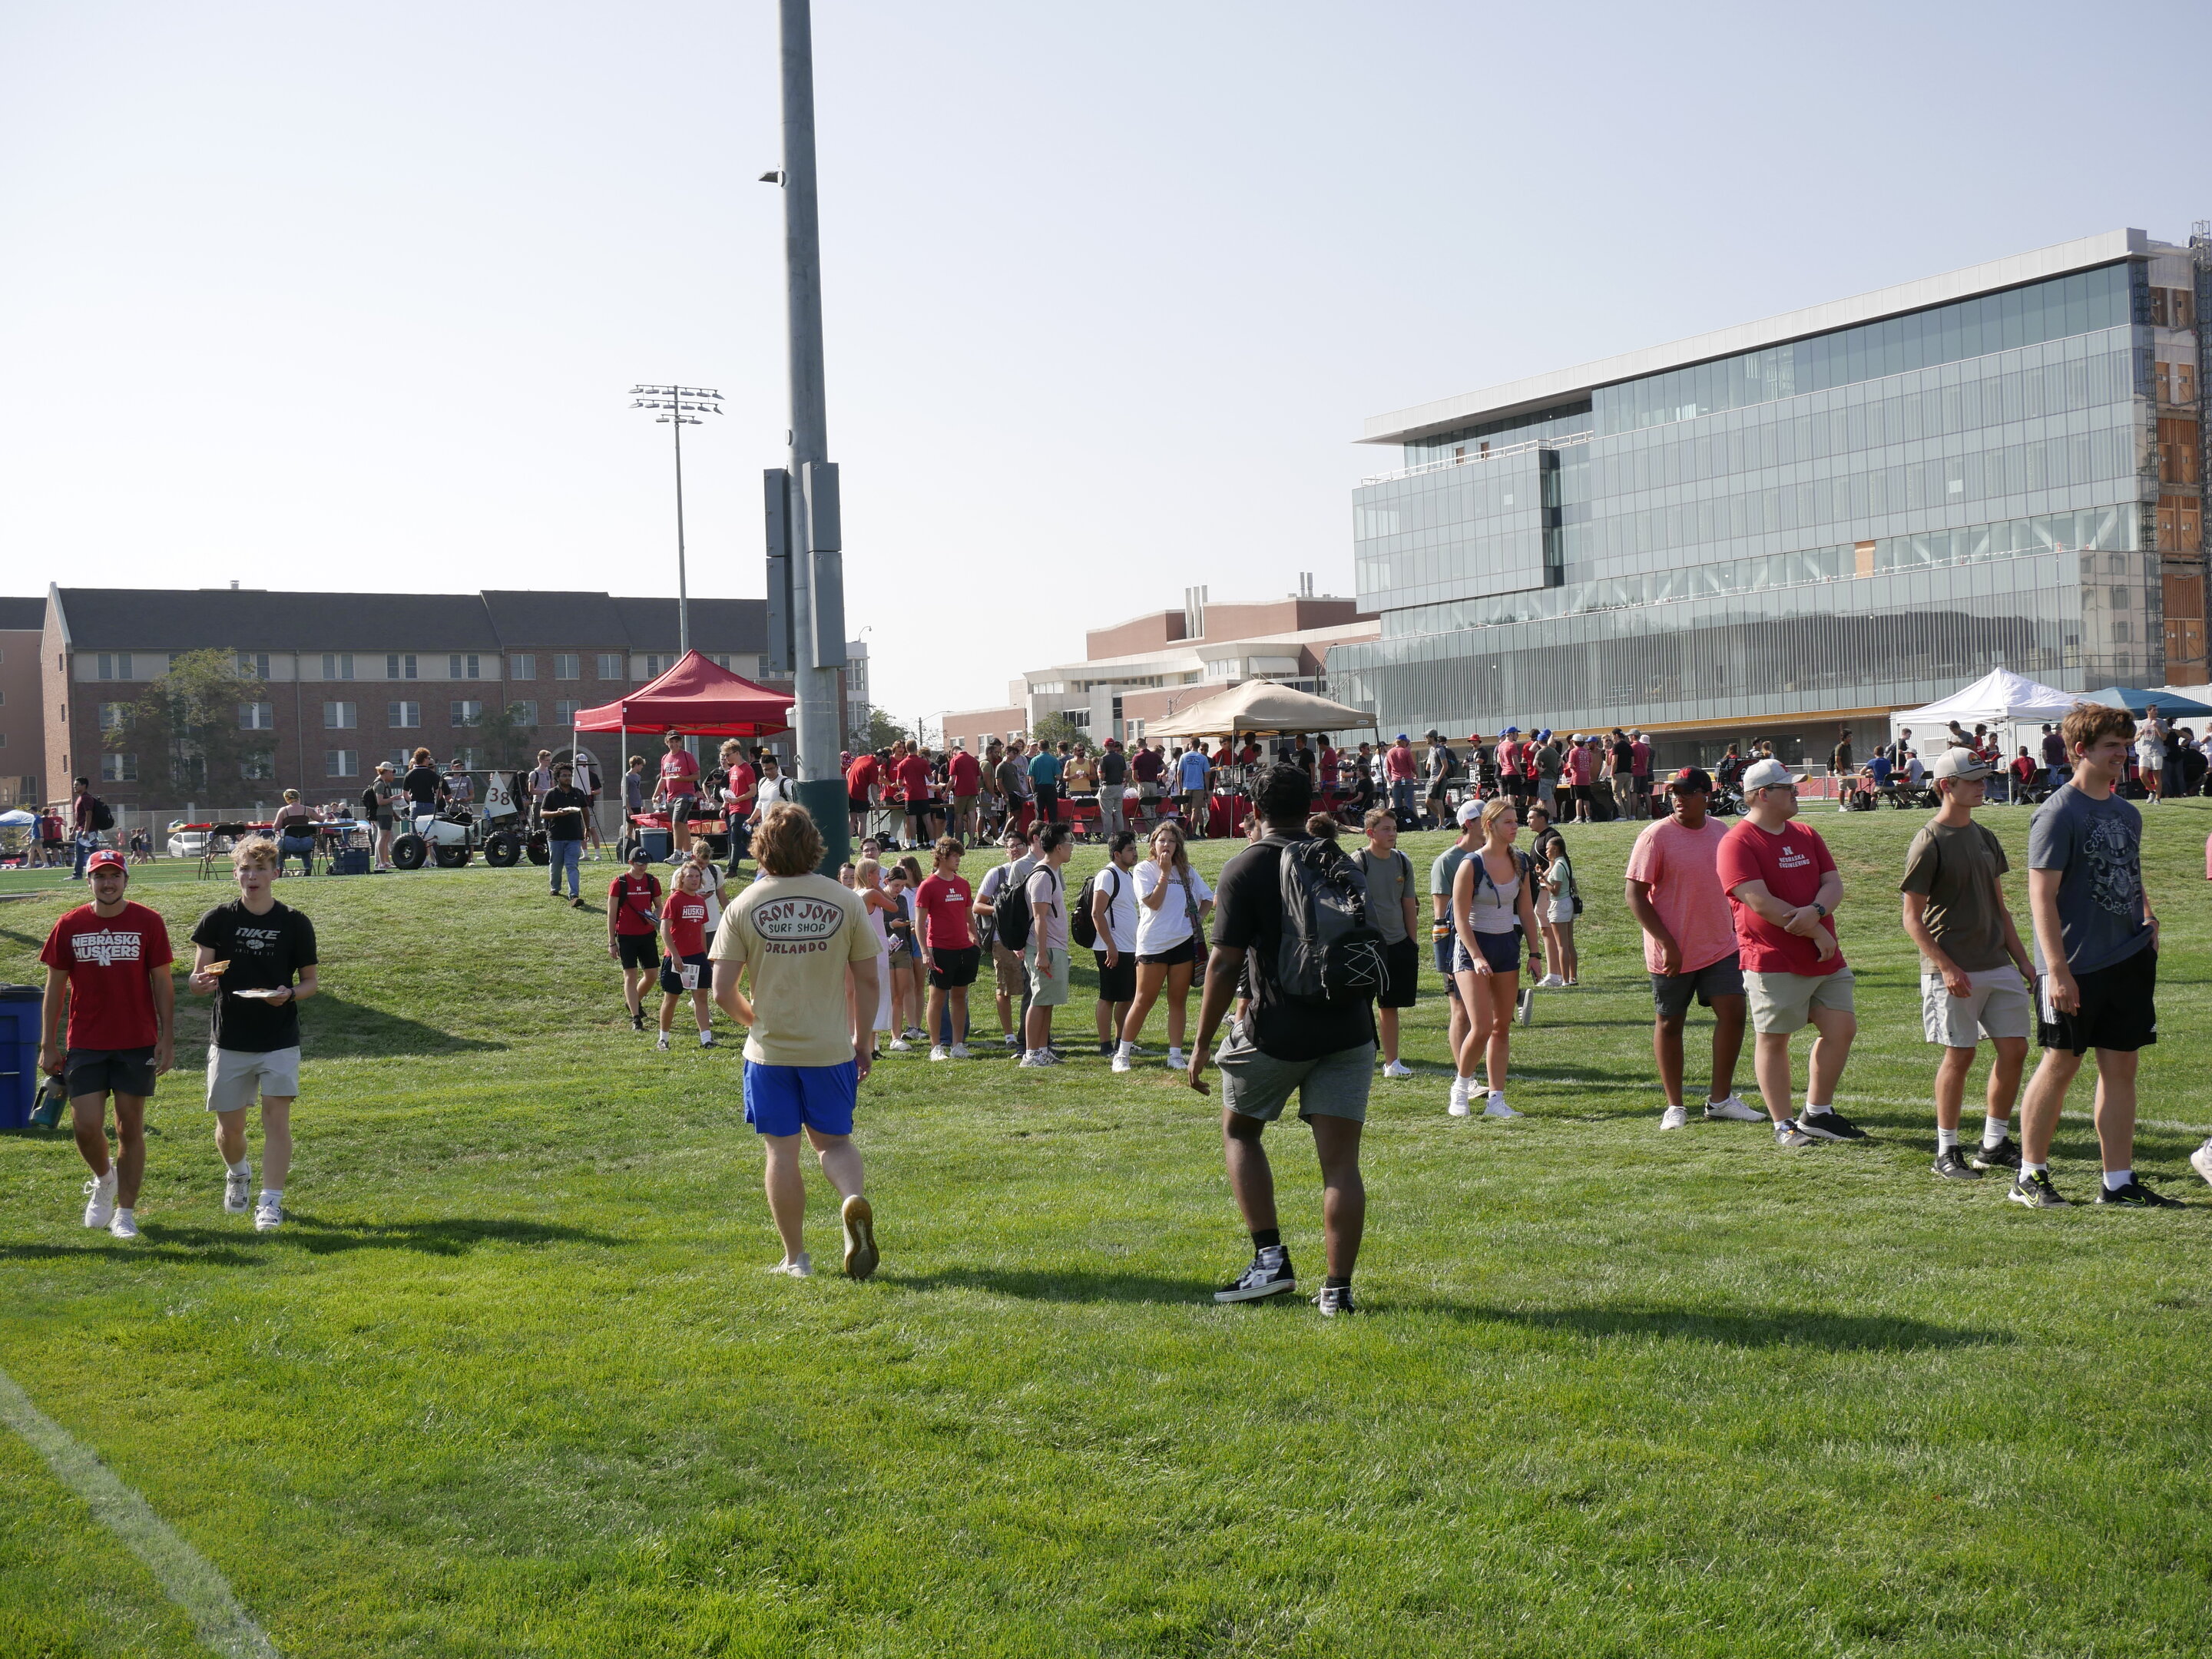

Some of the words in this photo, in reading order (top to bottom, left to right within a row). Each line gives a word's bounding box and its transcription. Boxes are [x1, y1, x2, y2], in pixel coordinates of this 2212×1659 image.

[489, 787, 510, 806] 38
[101, 851, 114, 859] N
[1782, 846, 1794, 856] N
[1779, 853, 1806, 863] NEBRASKA
[1779, 859, 1810, 868] ENGINEERING
[758, 902, 794, 927] RON
[798, 903, 839, 924] JON
[235, 926, 281, 940] NIKE
[768, 923, 793, 933] SURF
[797, 923, 826, 933] SHOP
[71, 934, 141, 948] NEBRASKA
[73, 945, 141, 959] HUSKERS
[765, 941, 828, 955] ORLANDO
[98, 953, 111, 966] N
